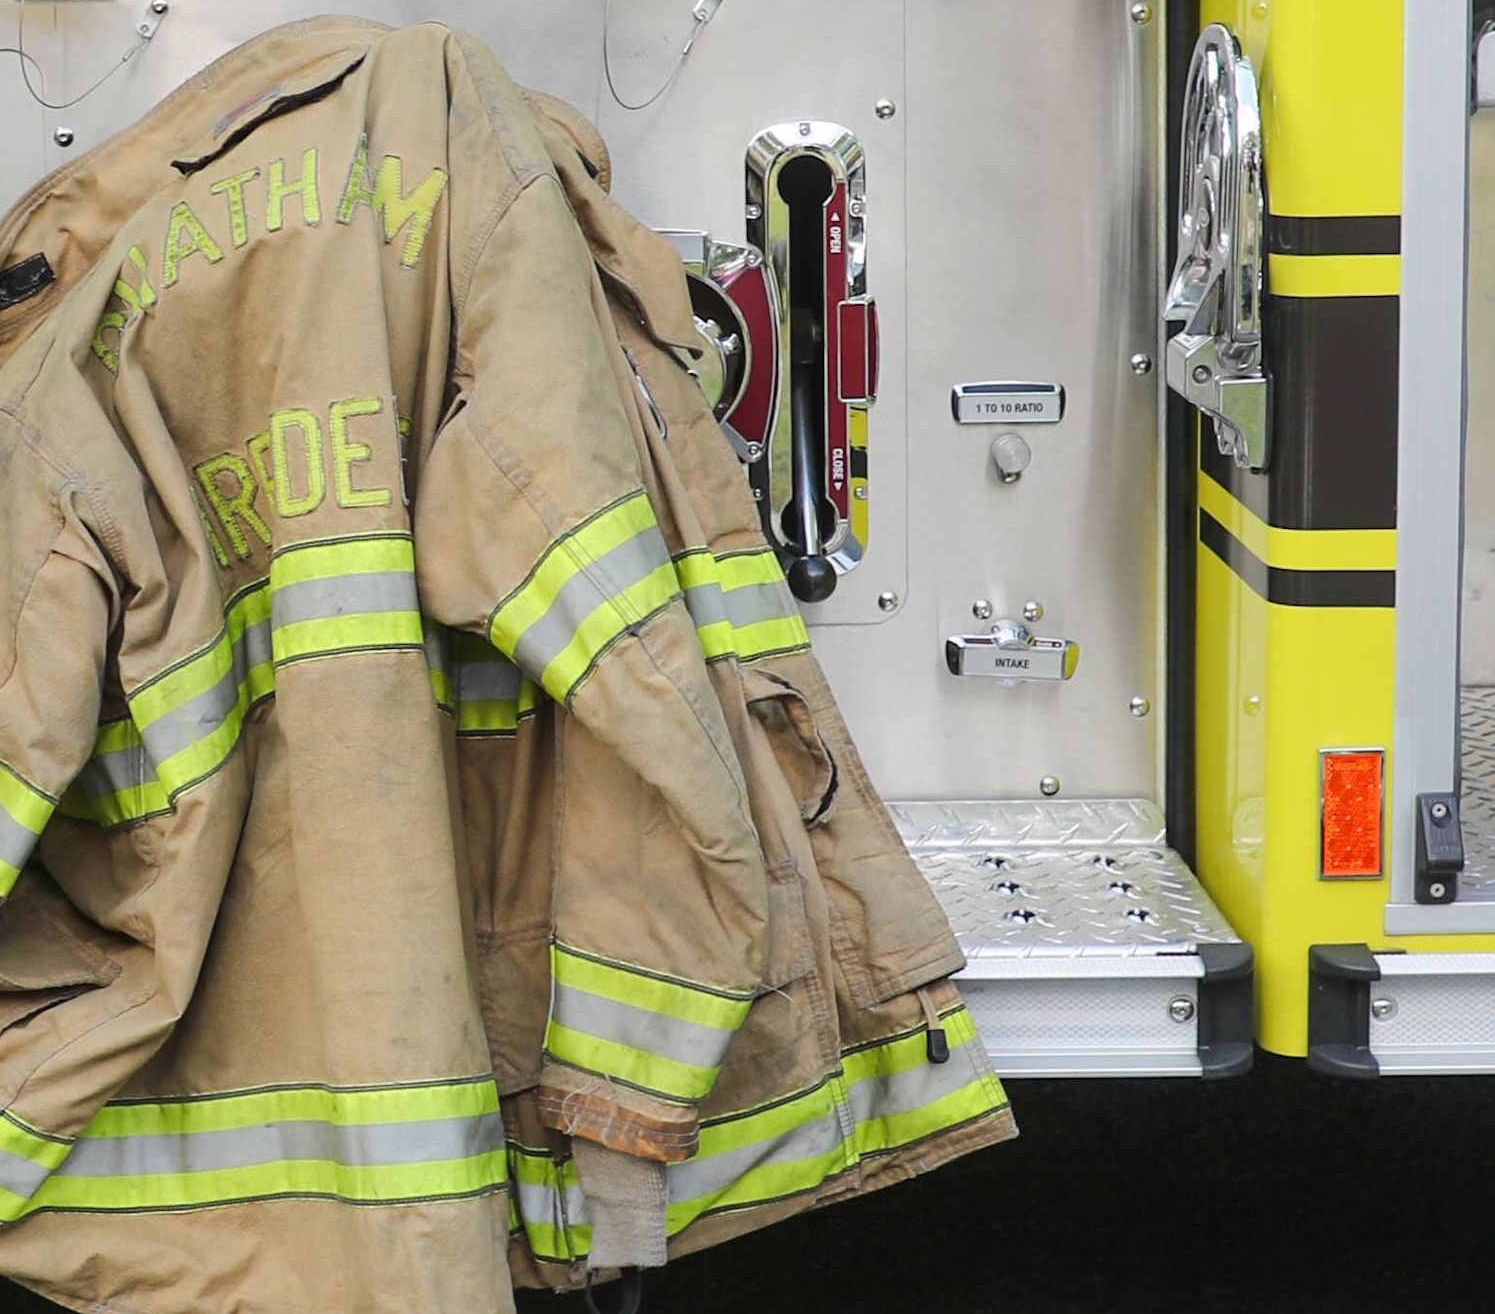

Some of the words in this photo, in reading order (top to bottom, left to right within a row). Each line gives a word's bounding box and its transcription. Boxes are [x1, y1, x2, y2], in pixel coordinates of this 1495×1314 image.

[830, 227, 841, 253] OPEN
[976, 405, 981, 413] 1
[985, 404, 998, 414] TO
[1000, 404, 1012, 413] 10
[1014, 403, 1043, 413] RATIO
[832, 448, 843, 479] CLOSE
[994, 658, 1030, 669] INTAKE
